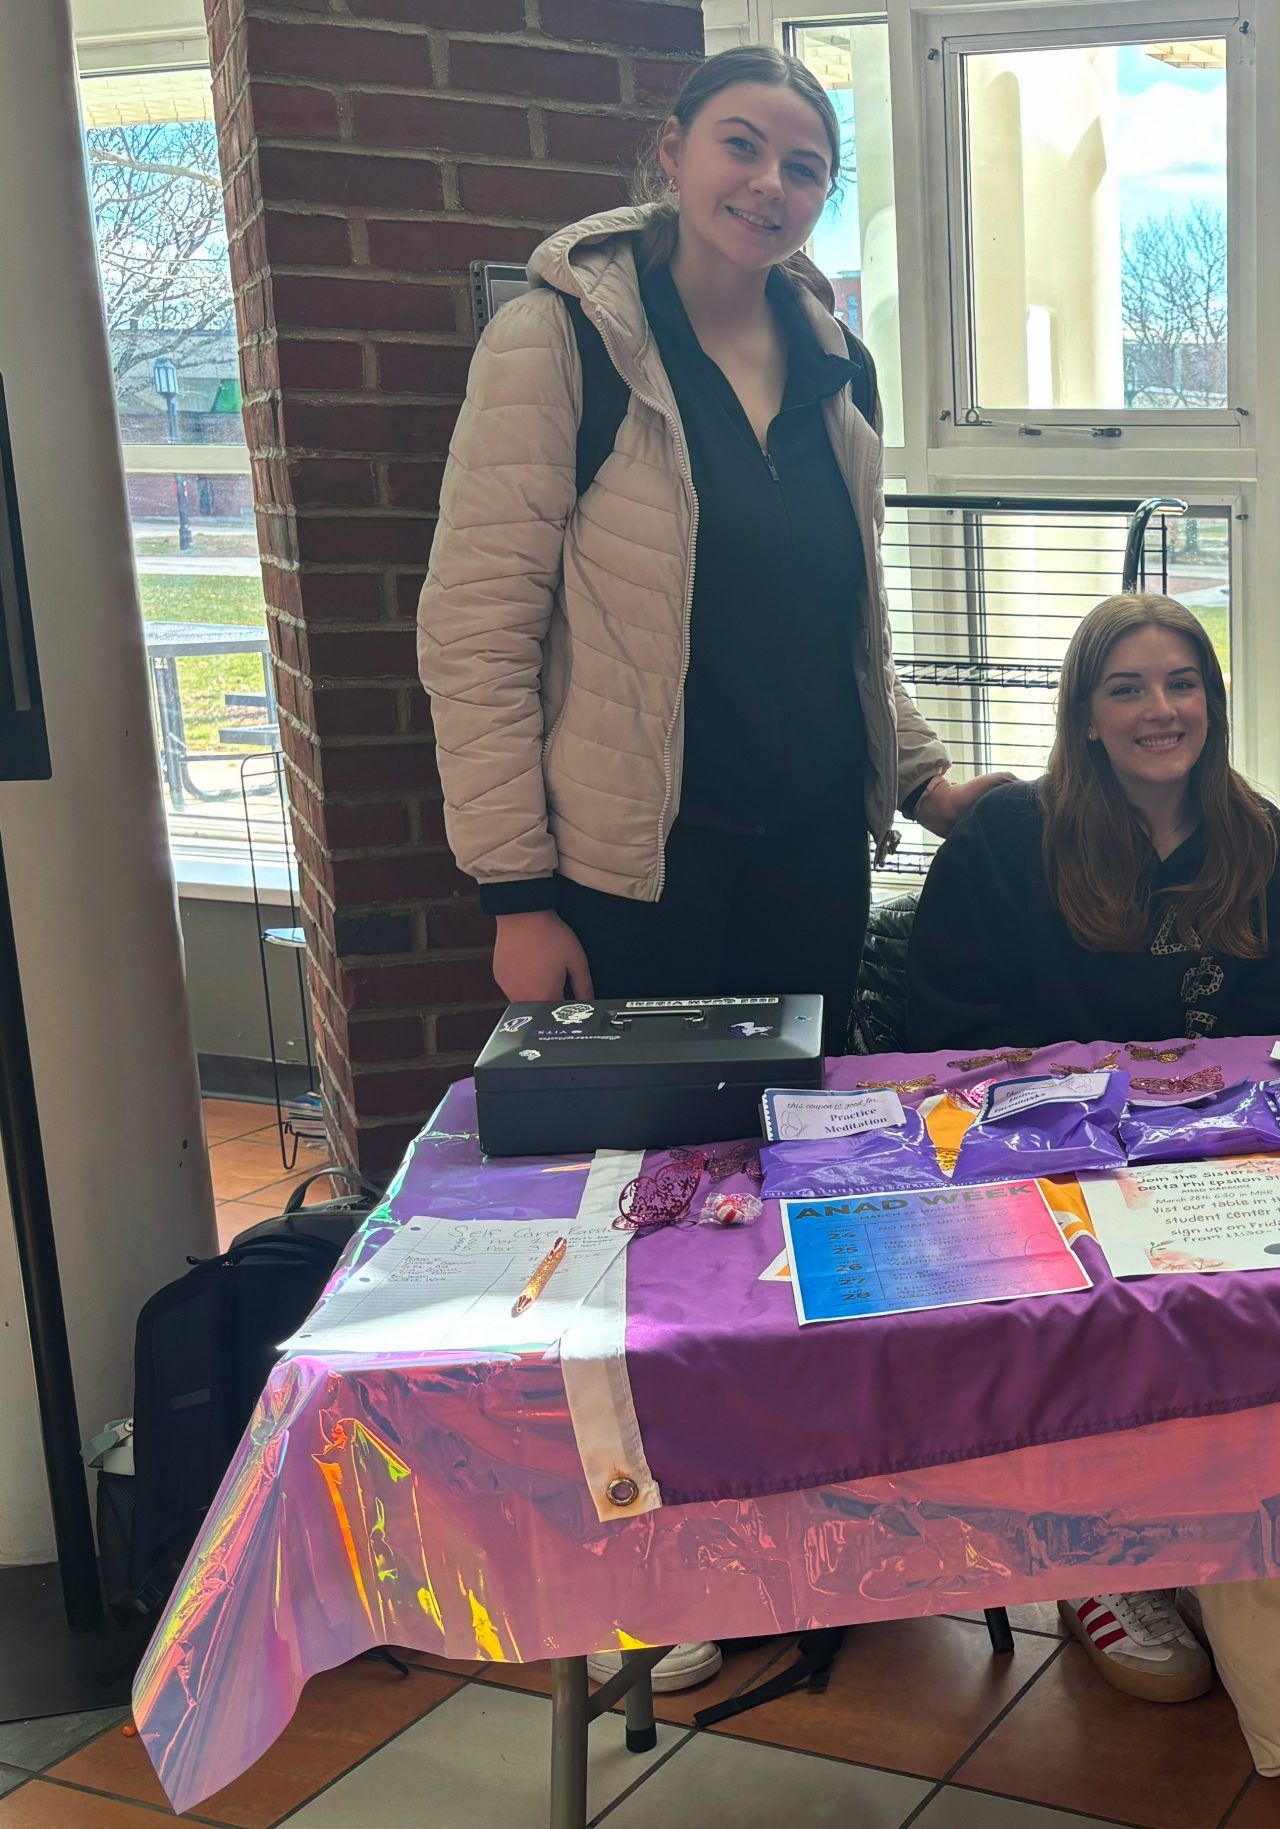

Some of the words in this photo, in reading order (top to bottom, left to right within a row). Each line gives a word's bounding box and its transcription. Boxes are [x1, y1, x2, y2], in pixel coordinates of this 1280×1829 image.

[805, 1103, 833, 1111] coupon
[845, 1101, 862, 1109] good
[830, 1108, 877, 1121] Practice
[825, 1117, 888, 1134] Meditation
[1203, 1169, 1255, 1178] Sisters
[1138, 1183, 1178, 1192] Delta
[1209, 1176, 1262, 1187] Epsilon
[794, 1199, 909, 1219] ANAD
[919, 1184, 1034, 1206] WEEK
[1156, 1196, 1187, 1204] March
[1212, 1199, 1249, 1208] table
[1165, 1213, 1221, 1225] student
[1226, 1209, 1271, 1219] center
[448, 1225, 502, 1238] Self
[513, 1227, 560, 1237] Care
[828, 1232, 857, 1240] 24
[1171, 1226, 1201, 1237] sign
[1205, 1226, 1223, 1234] up
[1183, 1235, 1221, 1243] from
[832, 1247, 859, 1255] 25
[836, 1264, 863, 1272] 26
[842, 1292, 871, 1301] 28
